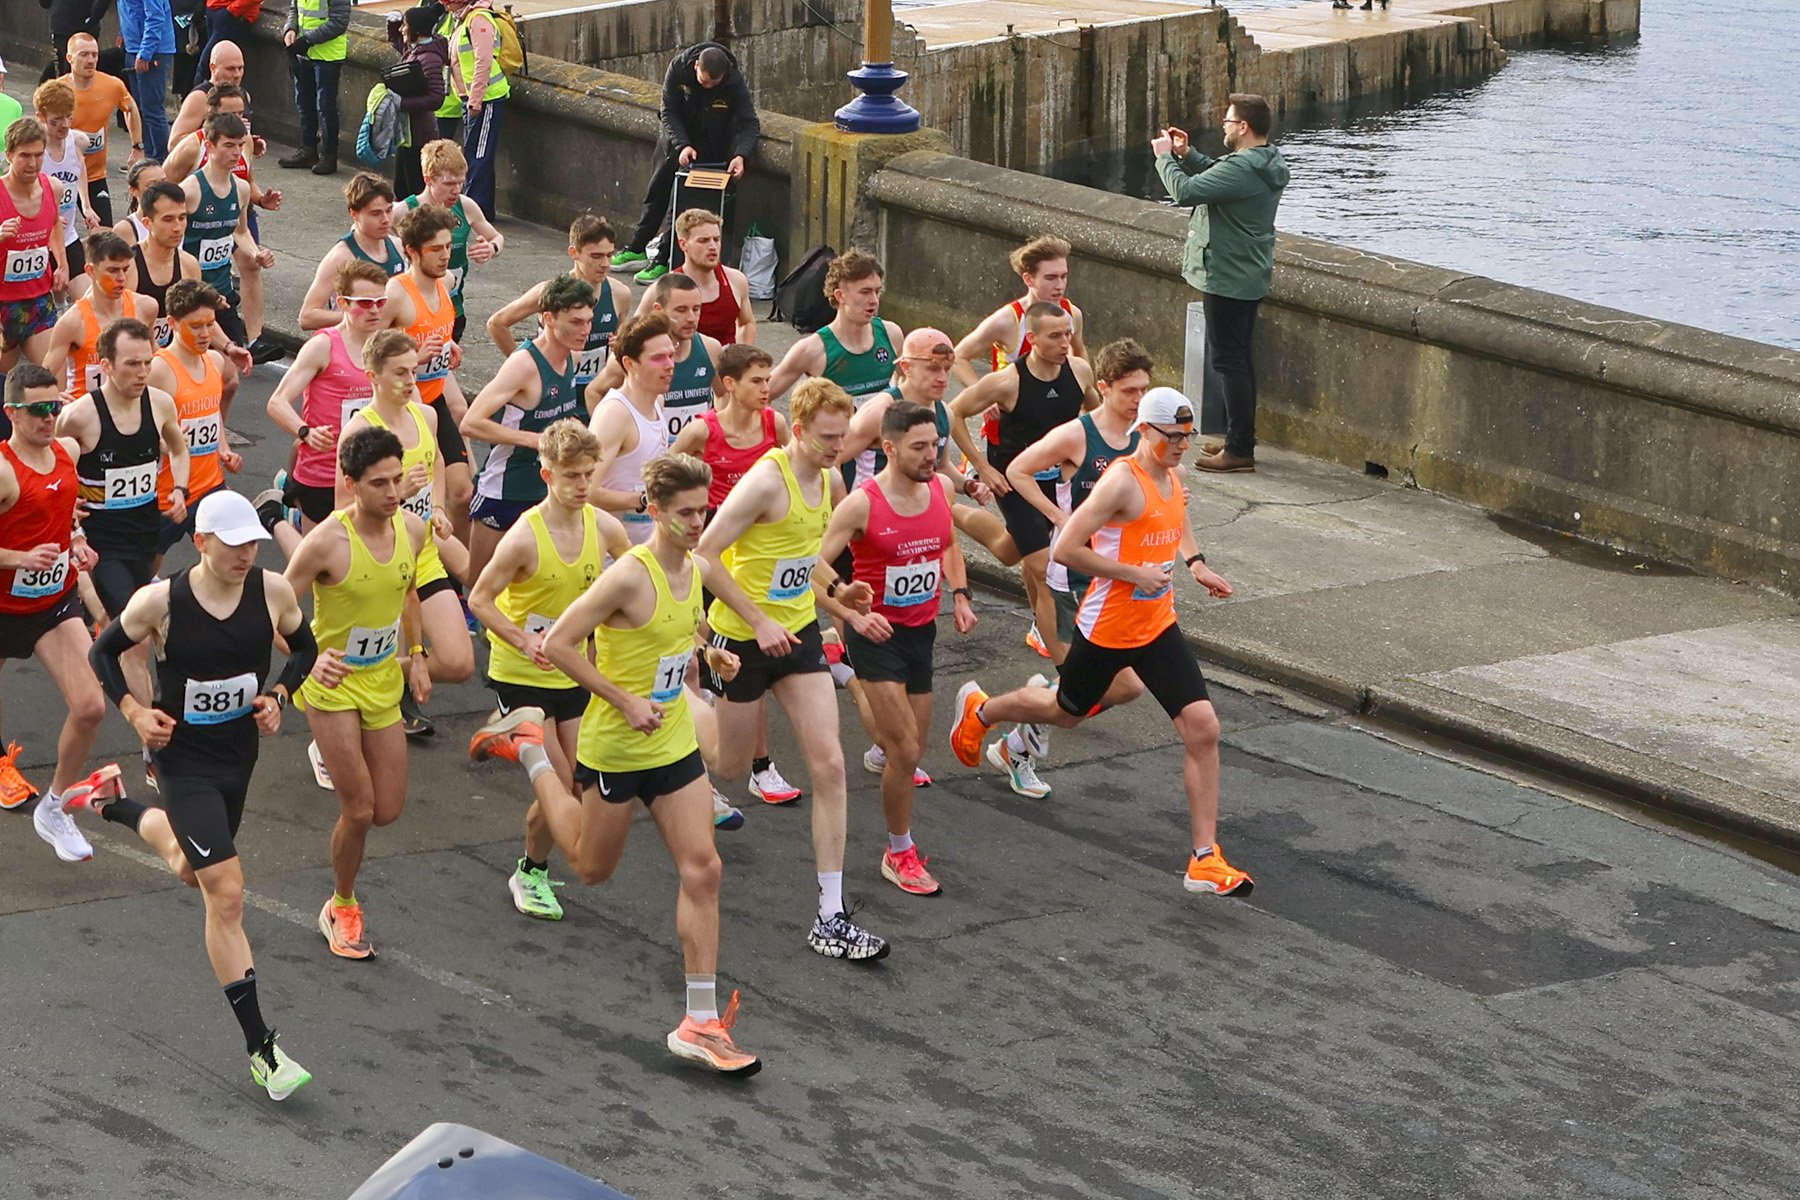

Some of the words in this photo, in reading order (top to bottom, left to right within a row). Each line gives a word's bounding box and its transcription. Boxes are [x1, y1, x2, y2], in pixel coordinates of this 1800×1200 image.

[204, 243, 230, 262] 055
[12, 256, 45, 273] 013
[425, 351, 450, 373] 135
[179, 394, 220, 415] ALEHOUS
[684, 387, 710, 399] UNIVERS
[187, 422, 218, 446] 132
[112, 473, 151, 498] 213
[897, 536, 941, 550] CAMBRIDGE
[1140, 526, 1182, 547] ALEHOUS
[22, 563, 64, 587] 366
[894, 571, 936, 597] 020
[357, 629, 397, 656] 112
[664, 663, 688, 690] 11
[192, 687, 245, 712] 381
